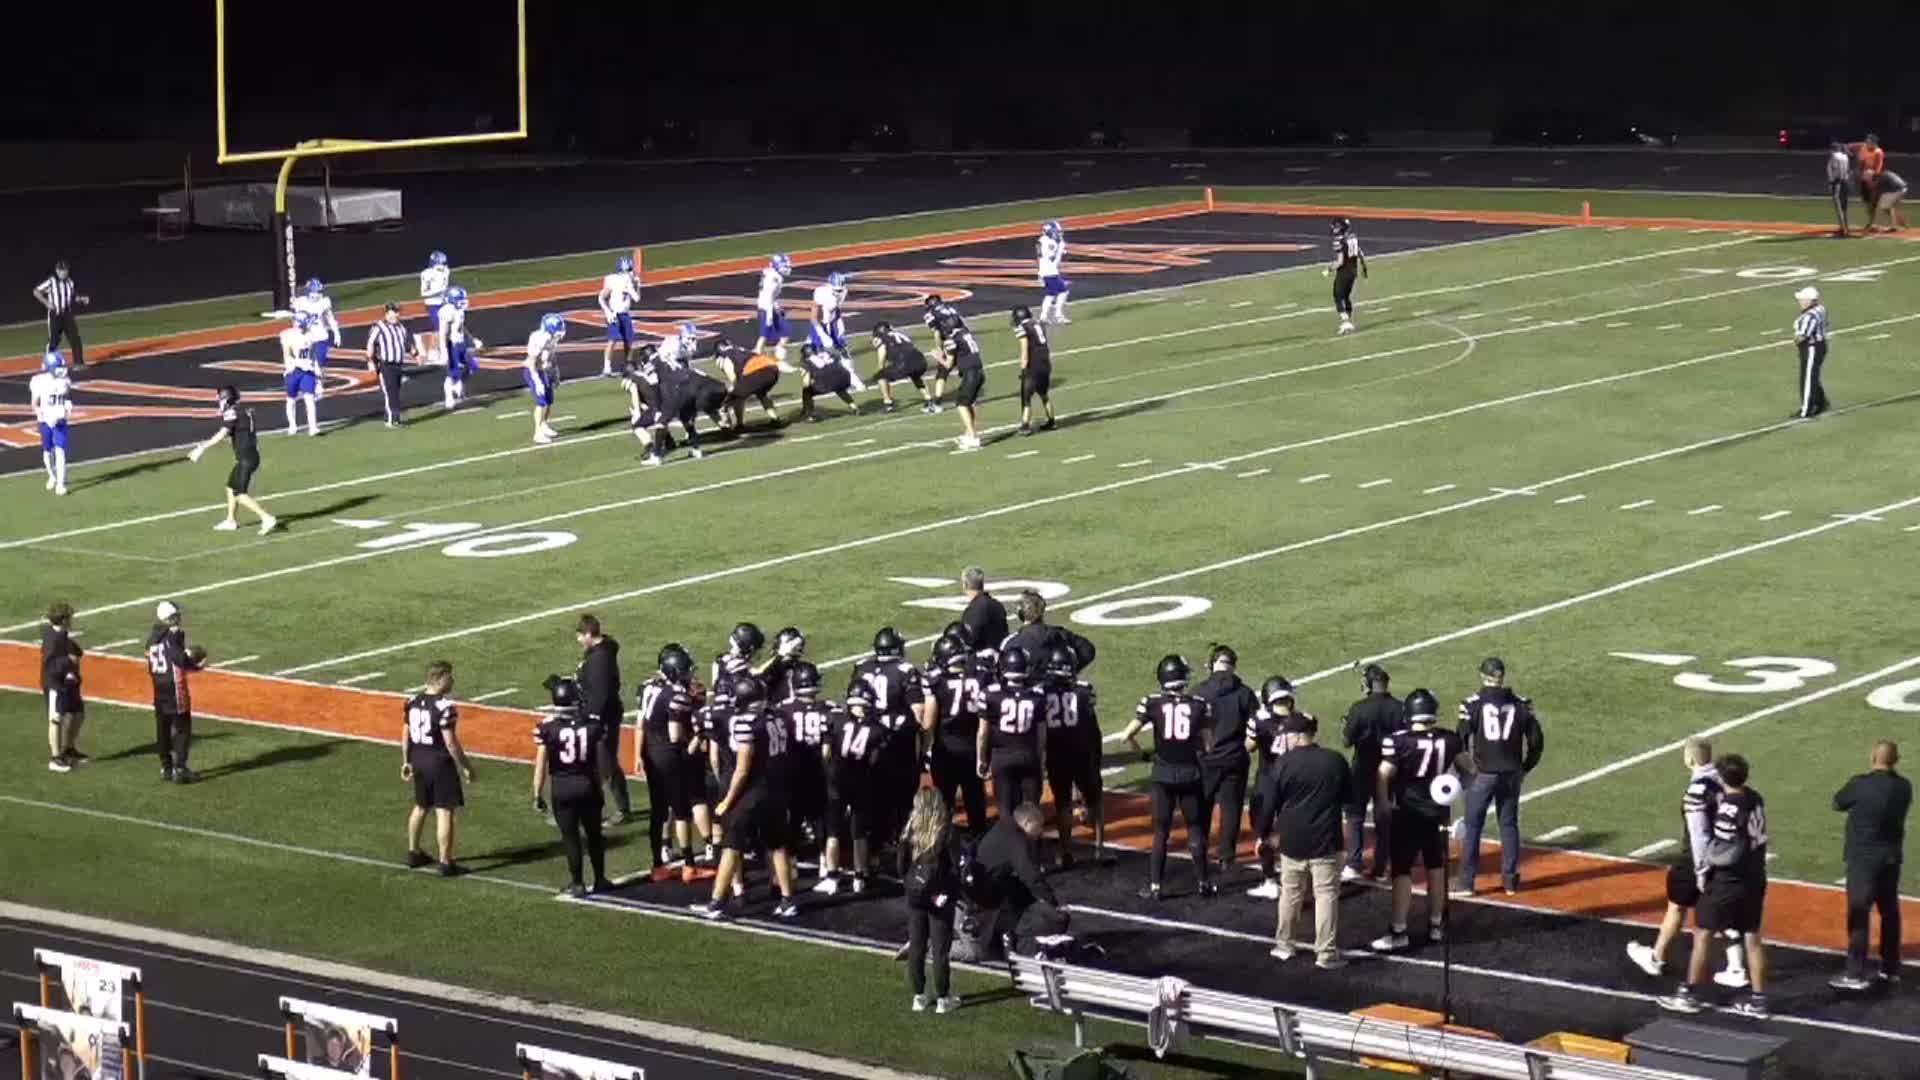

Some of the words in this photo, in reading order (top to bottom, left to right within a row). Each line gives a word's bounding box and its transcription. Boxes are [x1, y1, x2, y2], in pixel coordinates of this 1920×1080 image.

[947, 678, 981, 716] 73
[1045, 692, 1078, 729] 28
[793, 711, 820, 745] 19
[1000, 698, 1033, 734] 20
[1162, 703, 1192, 741] 16
[1482, 703, 1515, 741] 67
[559, 728, 587, 764] 31
[841, 721, 871, 758] 14
[1417, 738, 1446, 778] 71
